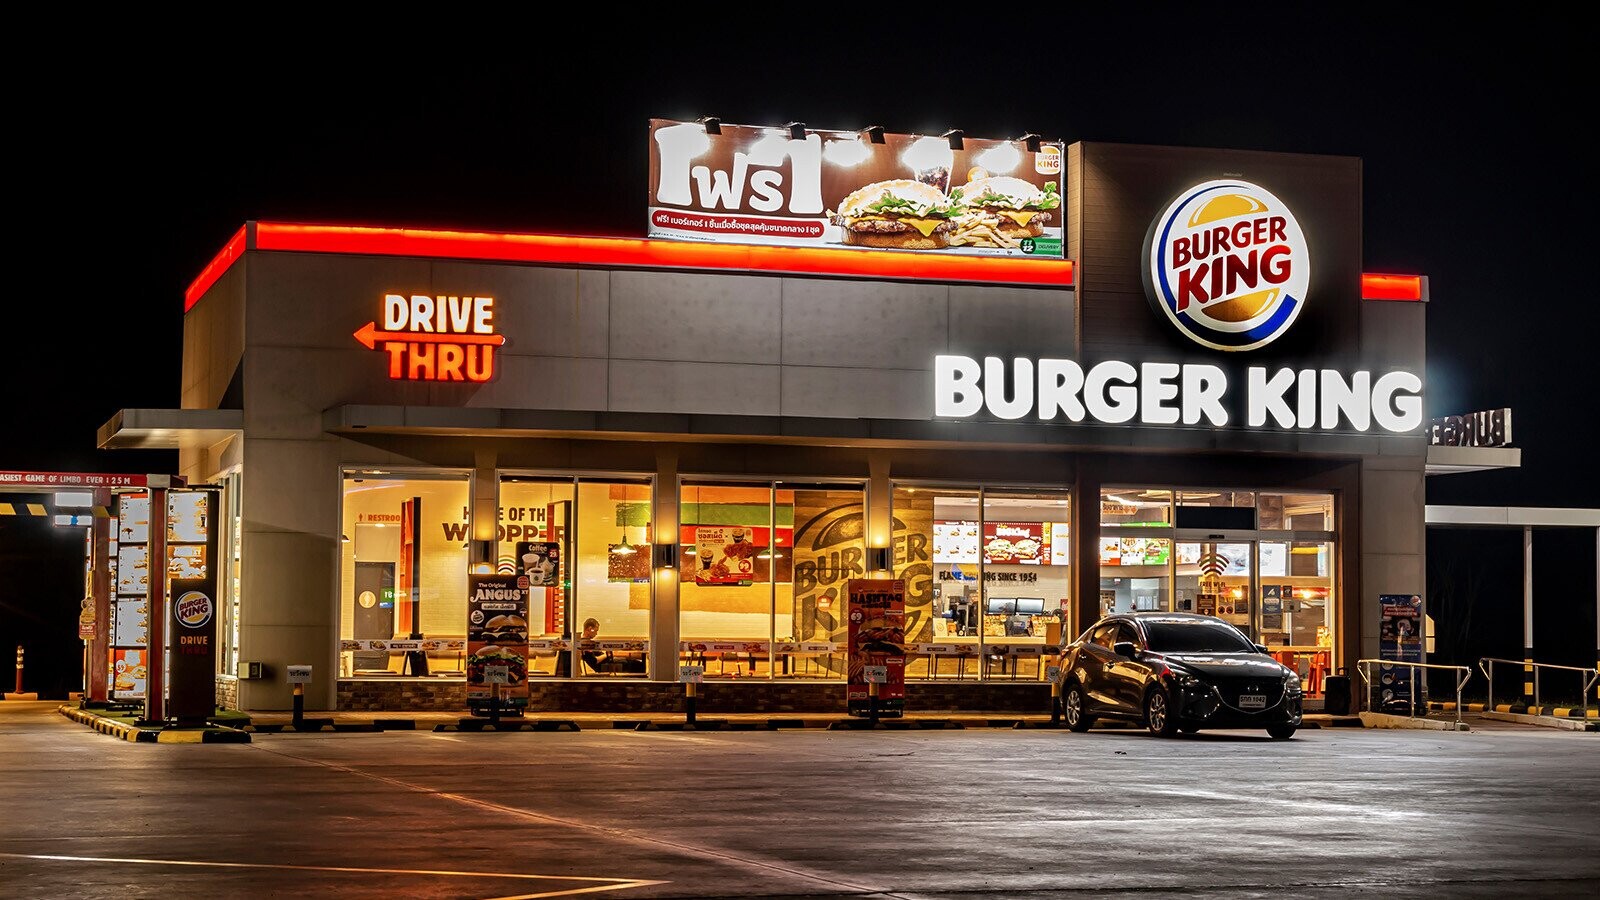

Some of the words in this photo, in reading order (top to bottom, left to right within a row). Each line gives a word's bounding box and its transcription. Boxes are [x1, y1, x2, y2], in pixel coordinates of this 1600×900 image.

[1173, 216, 1288, 269] BURGER
[1177, 245, 1292, 312] KING
[385, 294, 494, 334] DRIVE
[385, 341, 494, 381] THRU
[934, 354, 1230, 428] BURGER
[1247, 366, 1423, 433] KING
[25, 474, 46, 482] GAME
[48, 475, 58, 483] OF
[60, 475, 82, 484] LIMBO
[86, 476, 104, 484] EVER
[508, 507, 526, 521] OF
[529, 507, 546, 522] TH
[528, 544, 548, 552] Coffee
[795, 533, 928, 597] BURER
[997, 572, 1016, 582] SINCE
[1018, 572, 1037, 583] 1954
[180, 597, 207, 611] BURGER
[469, 589, 521, 603] ANGUS
[180, 603, 209, 620] KING
[180, 636, 208, 645] DRIVE
